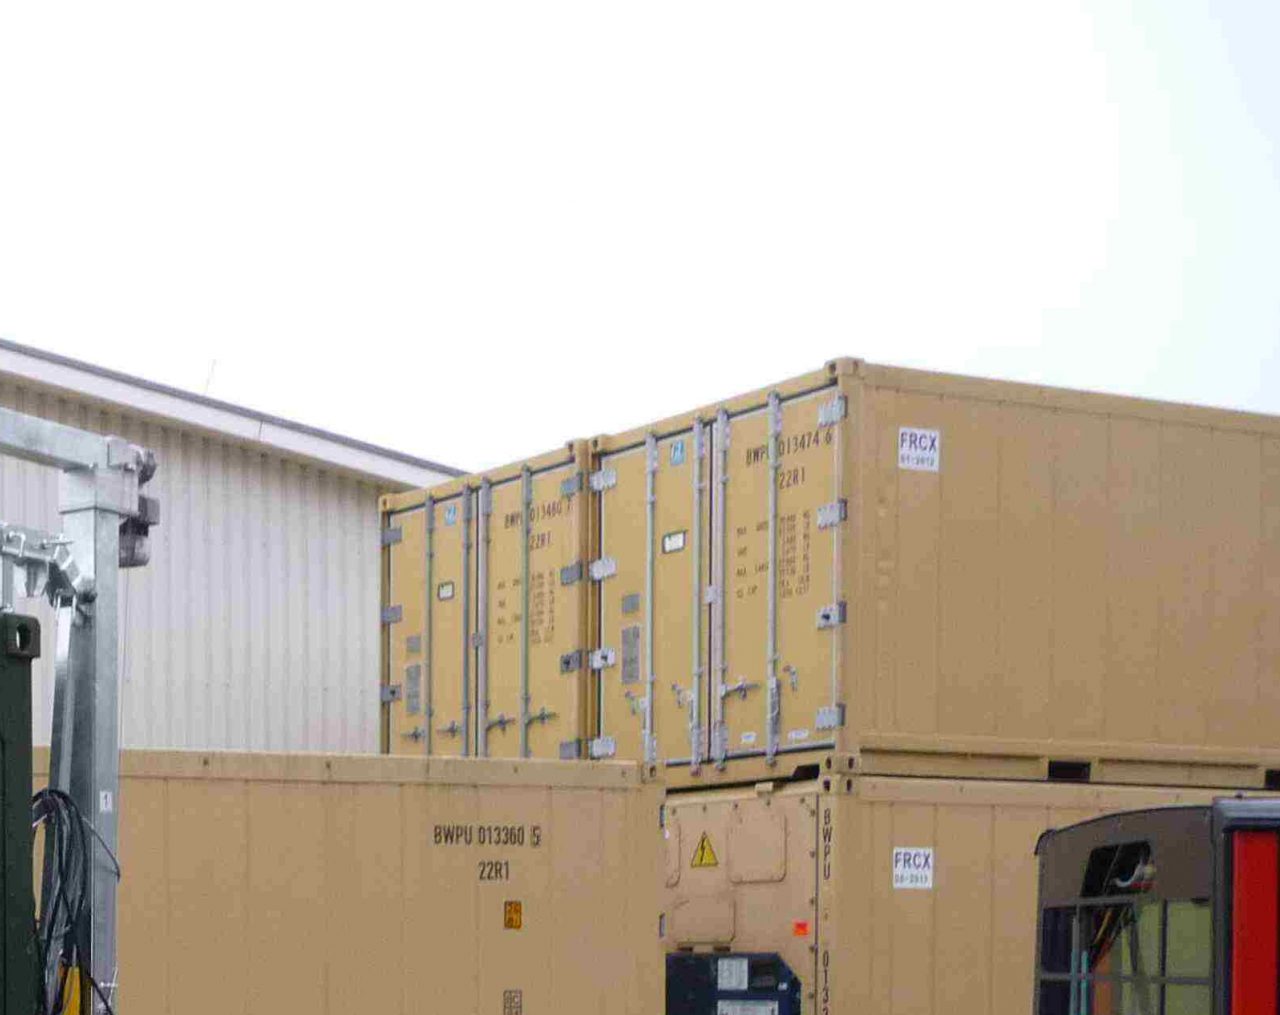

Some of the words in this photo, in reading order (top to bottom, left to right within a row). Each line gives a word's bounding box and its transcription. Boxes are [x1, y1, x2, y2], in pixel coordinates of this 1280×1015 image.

[779, 429, 820, 457] 013474
[900, 432, 937, 452] FRCX
[780, 467, 806, 490] 22R1
[434, 825, 473, 846] BWPU
[478, 825, 525, 847] 013360
[531, 825, 542, 848] 5
[822, 807, 833, 880] BWPU
[478, 860, 510, 881] 22R1
[894, 851, 931, 870] FRCX
